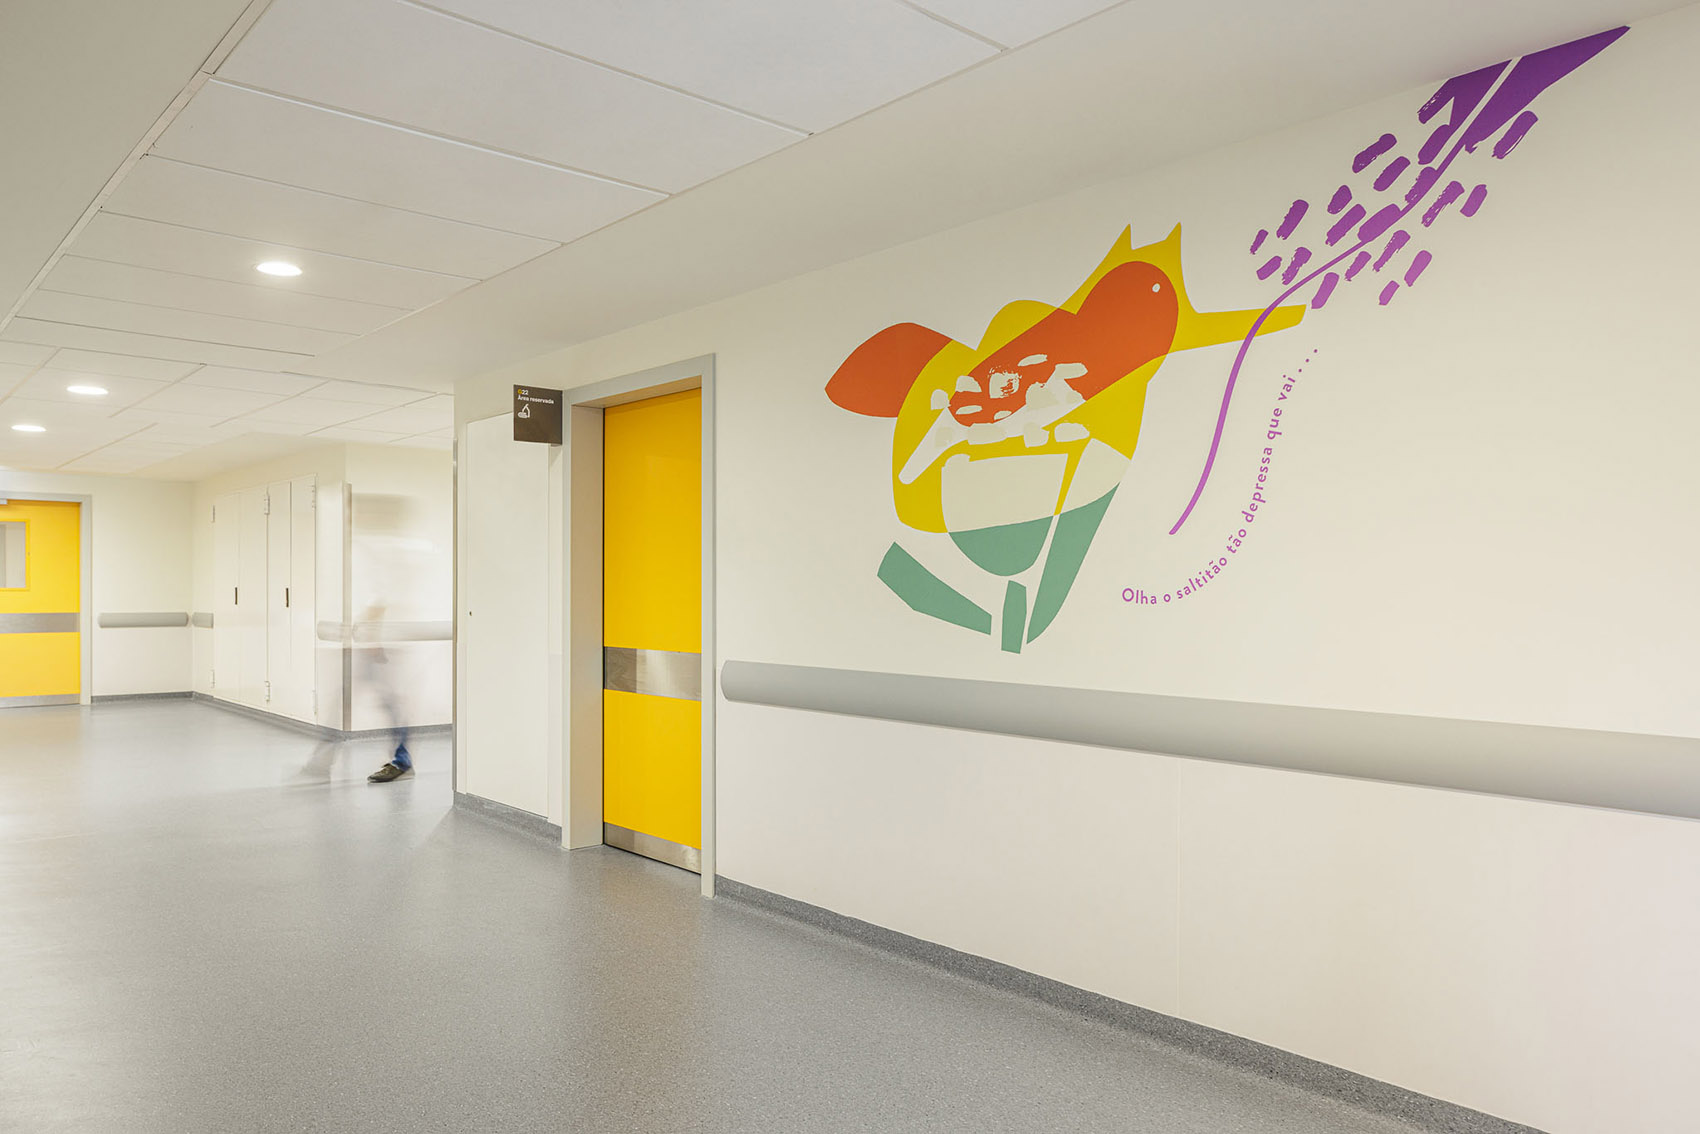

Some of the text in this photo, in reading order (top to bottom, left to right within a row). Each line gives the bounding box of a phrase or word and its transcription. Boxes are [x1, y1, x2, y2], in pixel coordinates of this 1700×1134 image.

[1121, 587, 1158, 606] Olha
[1162, 592, 1172, 604] o
[1175, 556, 1228, 600] saltitão
[1225, 528, 1248, 555] tão
[1241, 447, 1273, 523] depressa
[1266, 407, 1283, 441] que
